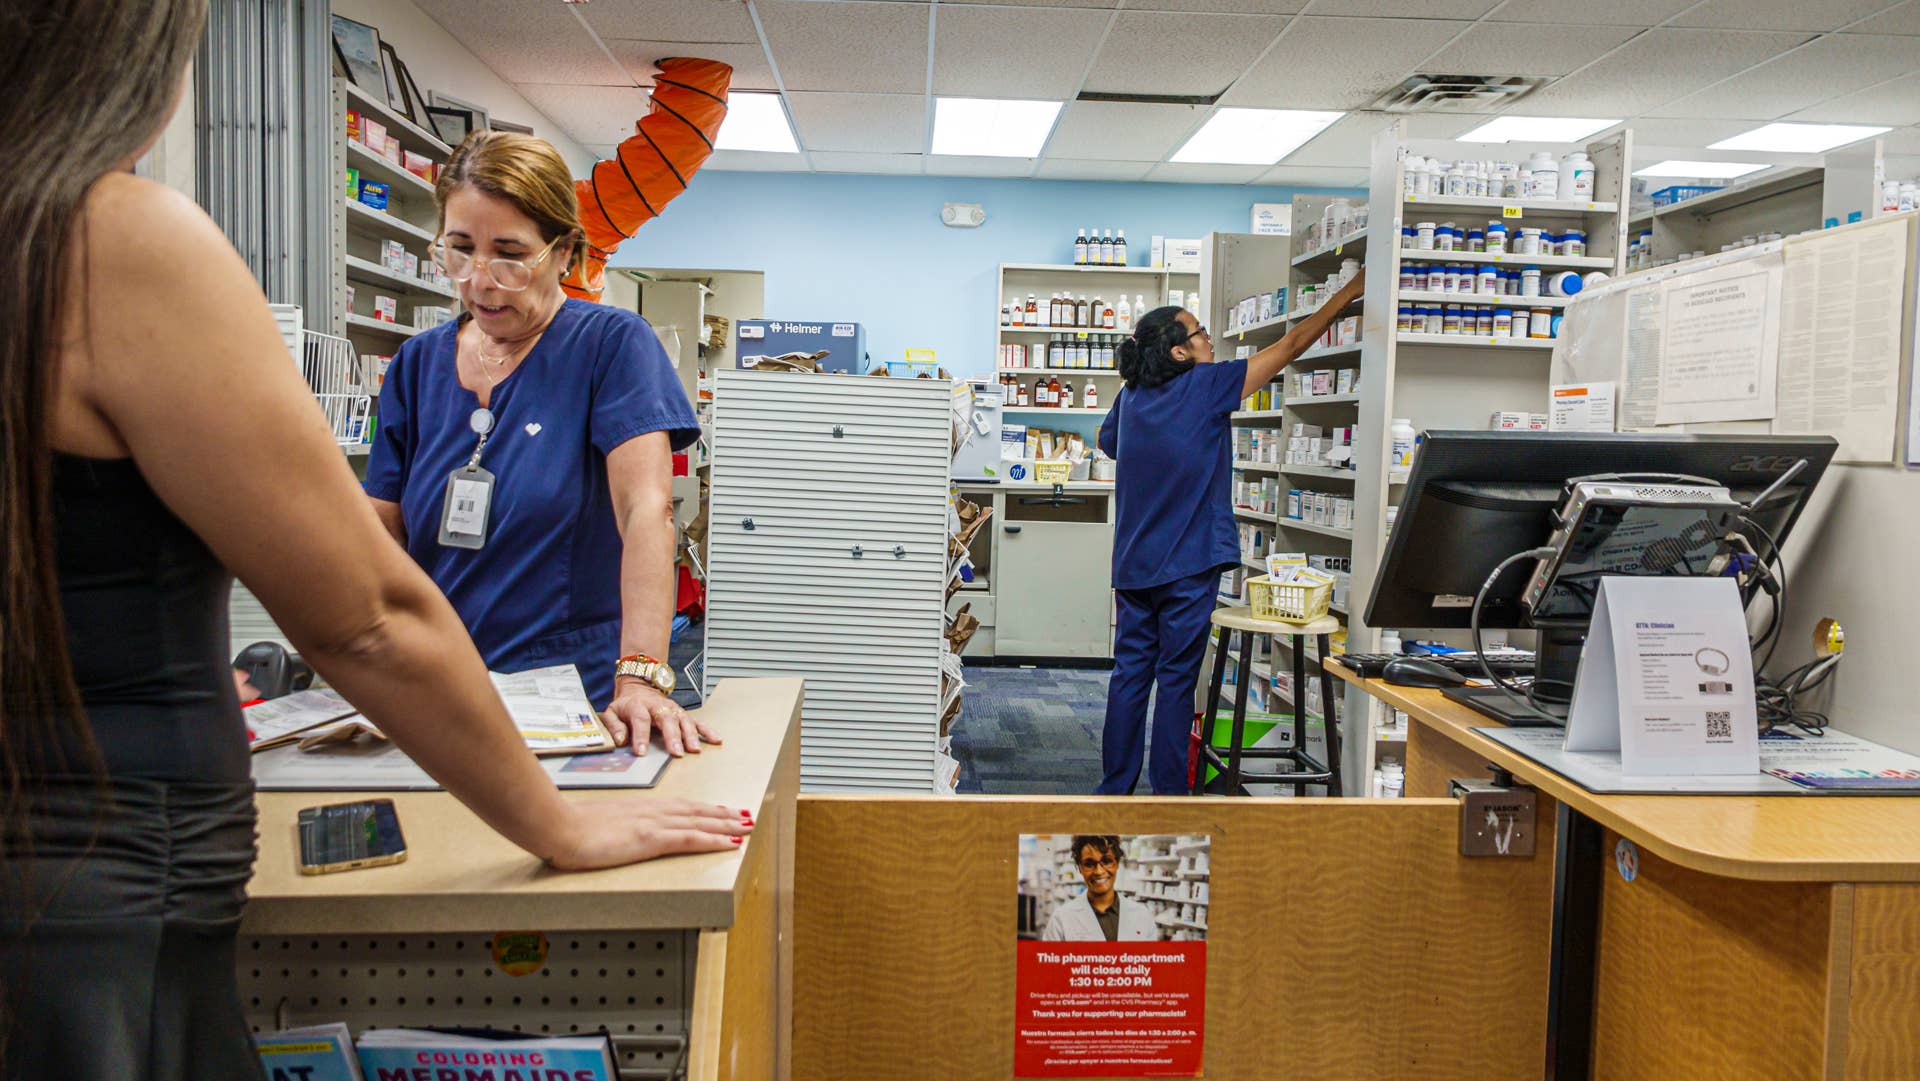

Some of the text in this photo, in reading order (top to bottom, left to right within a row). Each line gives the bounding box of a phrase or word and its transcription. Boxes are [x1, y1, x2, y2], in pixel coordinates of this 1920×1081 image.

[784, 323, 823, 334] Helmer
[1037, 953, 1185, 965] This pharmacy department
[1071, 966, 1151, 977] will close daily
[1070, 977, 1152, 987] 1:30 to 2:00 PM
[1032, 1010, 1055, 1018] Thank
[1057, 1011, 1071, 1019] you
[1071, 1010, 1082, 1018] for
[1083, 1010, 1124, 1019] supporting
[1138, 1010, 1186, 1019] pharmacists!
[416, 1051, 545, 1065] COLORING
